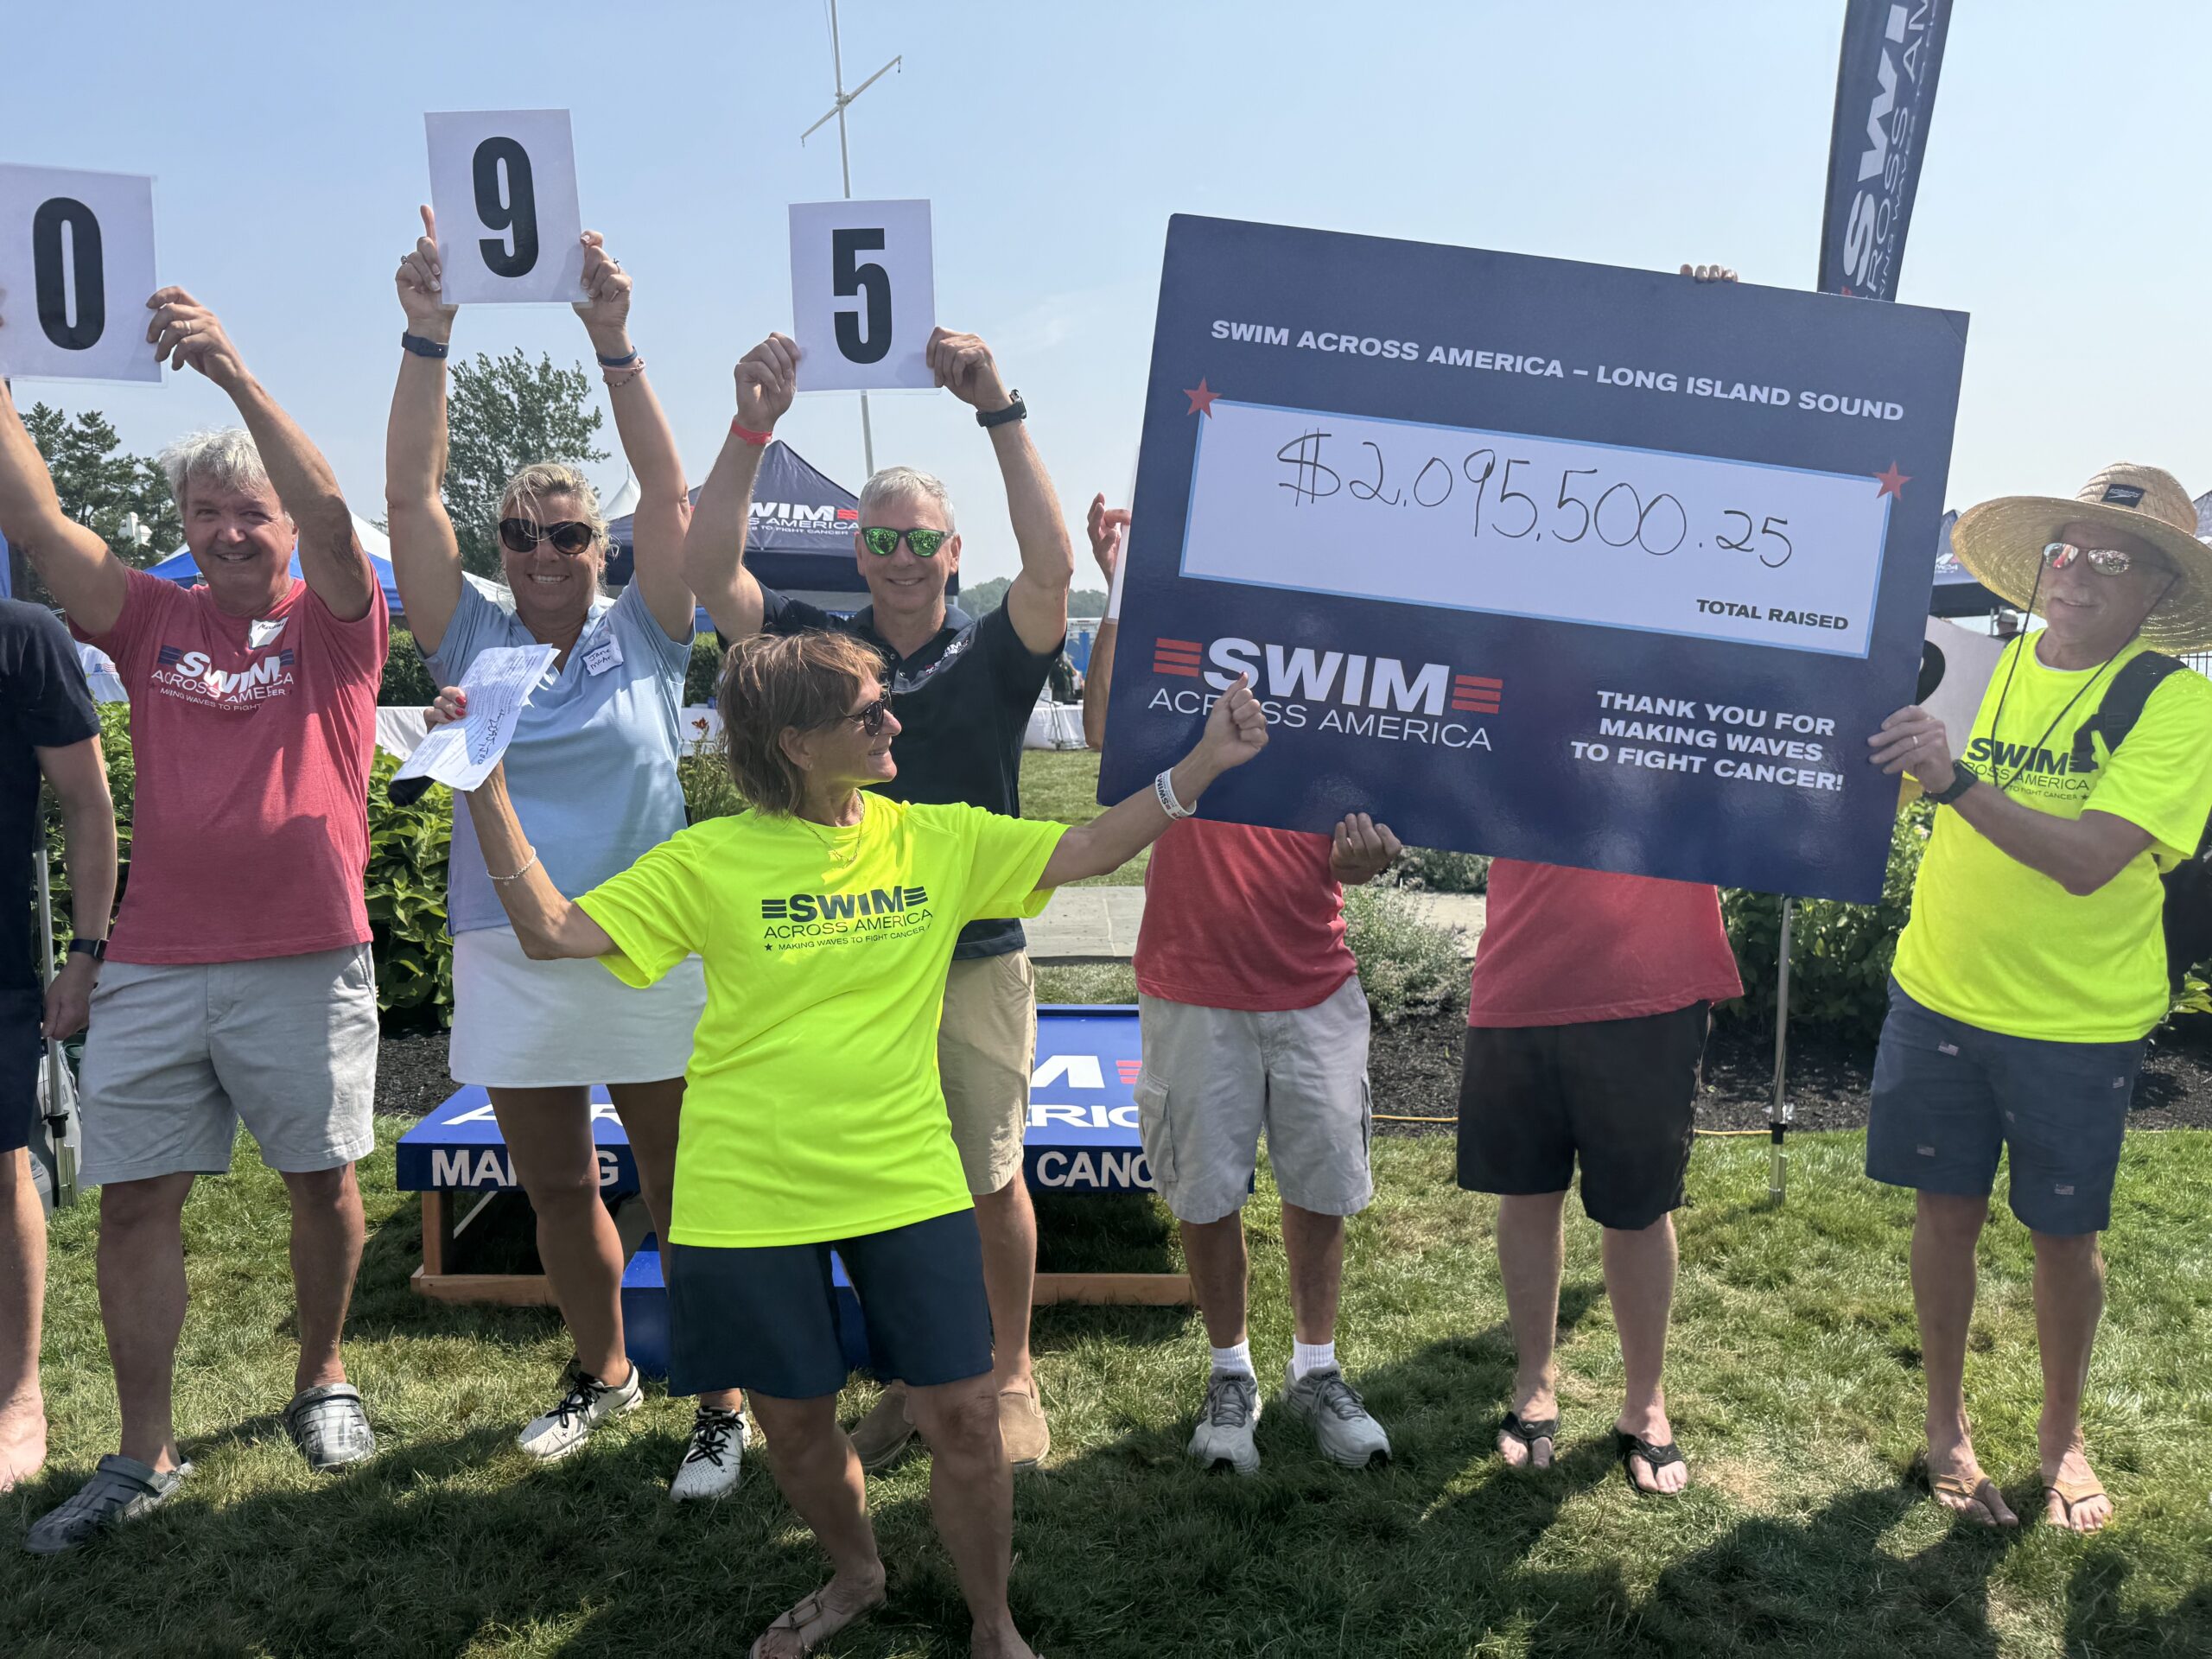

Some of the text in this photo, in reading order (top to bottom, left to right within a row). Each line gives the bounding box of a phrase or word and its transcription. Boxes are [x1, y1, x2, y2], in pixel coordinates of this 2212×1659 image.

[1843, 3, 1908, 286] SWI
[473, 137, 539, 278] 9
[1867, 107, 1909, 292] ROSS
[33, 197, 105, 350] 0
[1879, 233, 1894, 299] KING
[831, 228, 893, 364] 5
[1211, 320, 1291, 346] SWIM
[1296, 330, 1420, 361] ACROSS
[1427, 346, 1565, 378] AMERICA
[1596, 365, 1678, 392] LONG
[1686, 376, 1791, 406] ISLAND
[1797, 391, 1904, 421] SOUND
[748, 502, 835, 521] WIM
[766, 518, 860, 530] AMERICA
[1696, 599, 1849, 630] TOTAL RAISED
[151, 670, 221, 698] ACROSS
[175, 652, 281, 694] SWIM
[1203, 637, 1450, 716] SWIM
[186, 695, 216, 708] WAVES
[1147, 688, 1492, 751] ACSS AMERICA
[1597, 690, 1835, 736] THANK YOU FOR
[1599, 717, 1824, 761] MAKING WAVES
[1967, 737, 2070, 776] SWIM
[1570, 741, 1845, 791] TO FIGHT CANCER!
[1965, 761, 2089, 791] ROSS AMERICA
[764, 909, 933, 939] ACROSS AMERICA
[789, 886, 905, 923] SWIM
[779, 941, 815, 950] MAKING
[817, 938, 849, 946] WAVES
[865, 933, 888, 942] FIGHT
[890, 926, 925, 939] CANCER
[432, 1149, 619, 1186] MAG
[1037, 1151, 1154, 1188] CANC
